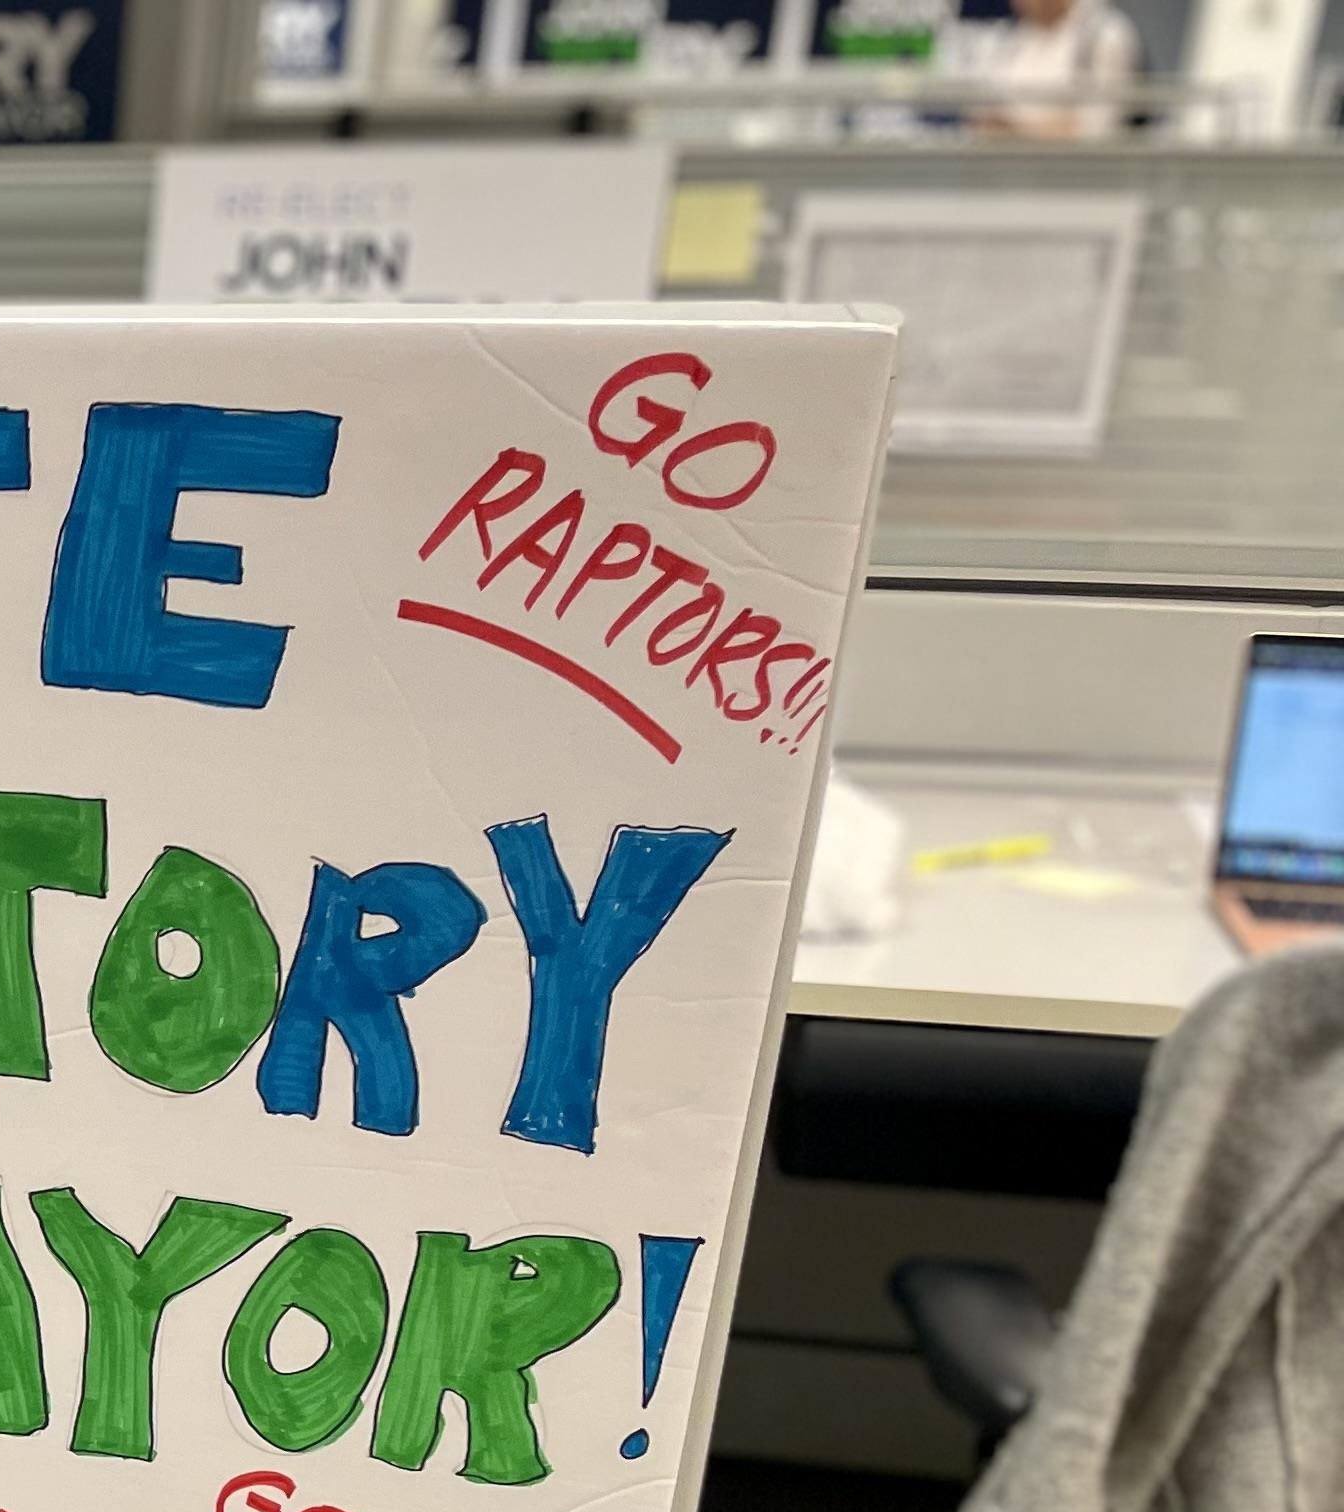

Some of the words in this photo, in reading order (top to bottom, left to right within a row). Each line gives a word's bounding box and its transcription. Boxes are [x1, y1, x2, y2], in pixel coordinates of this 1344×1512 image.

[216, 231, 410, 291] JOHN
[588, 352, 776, 511] GO
[418, 447, 831, 754] RAPTORS!!!
